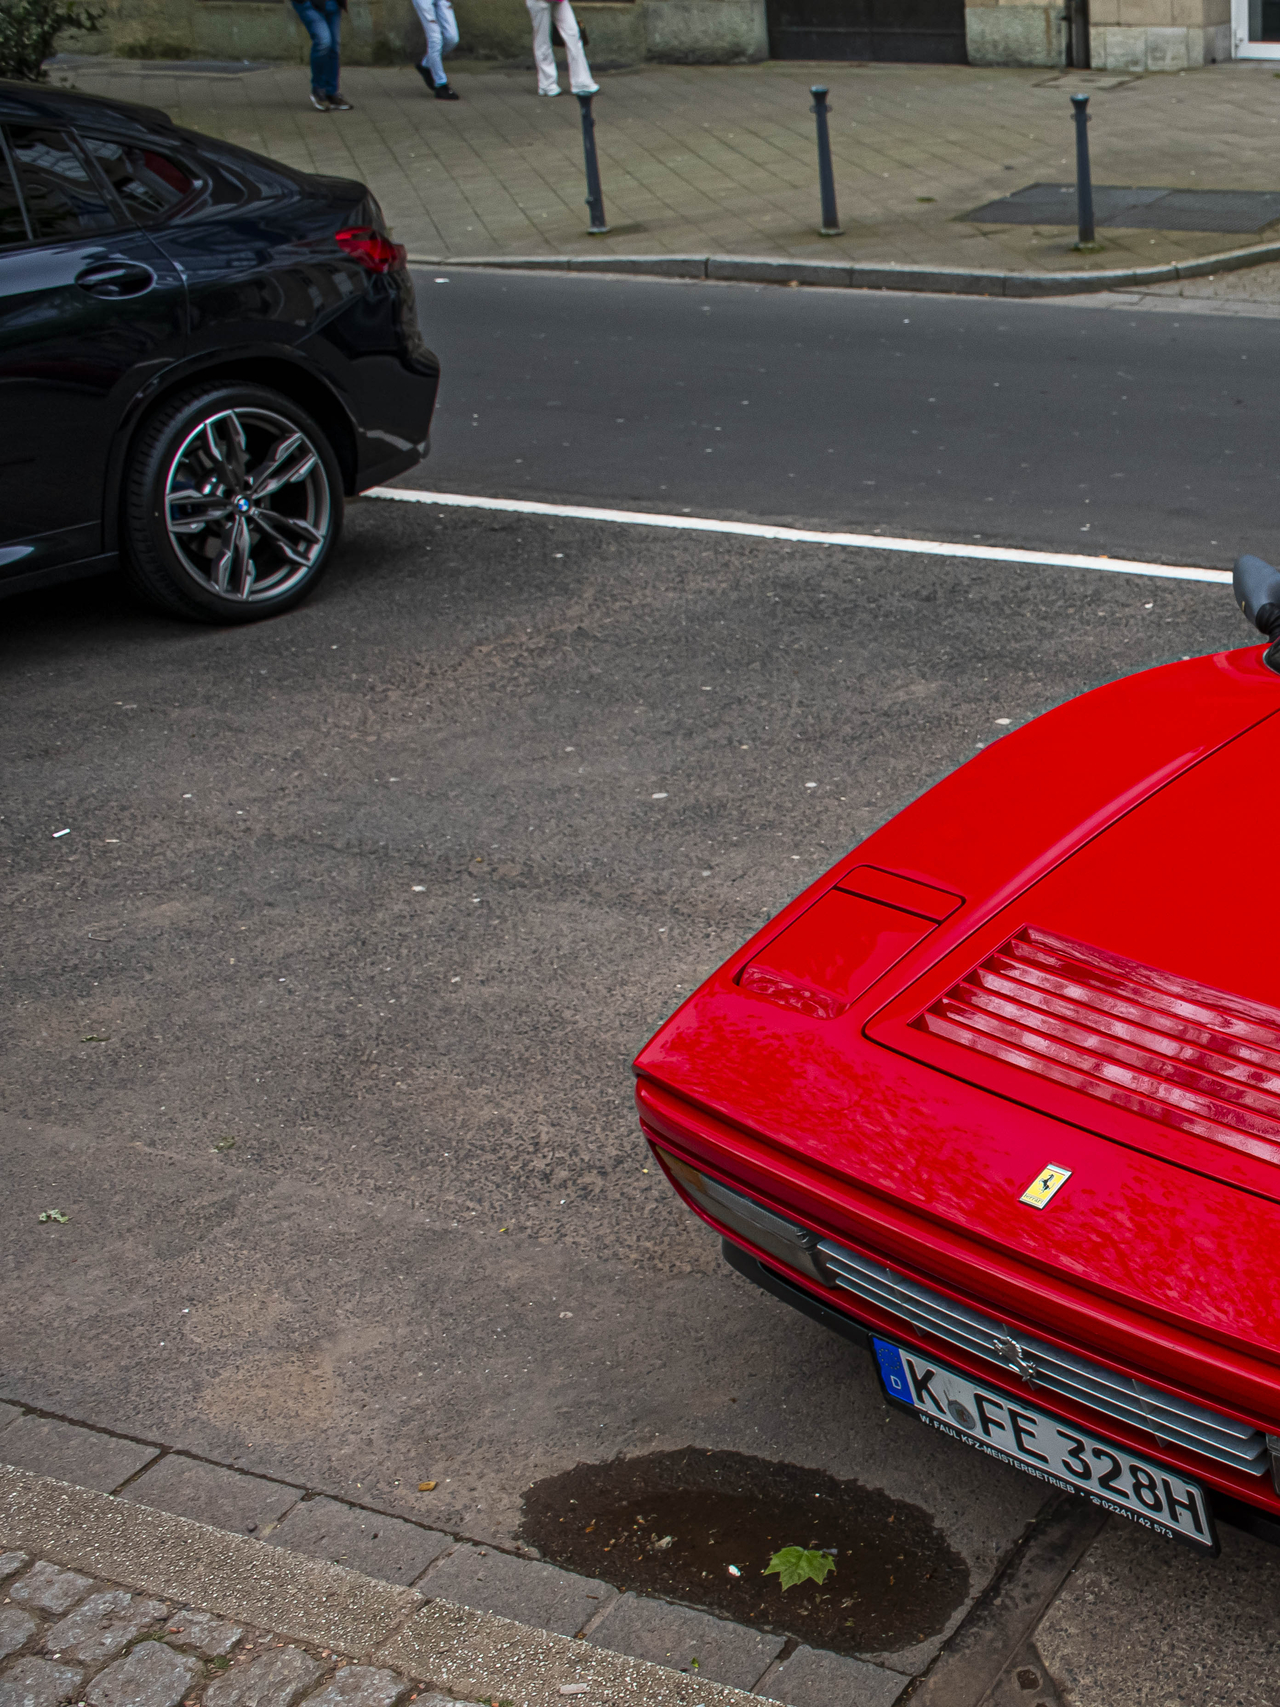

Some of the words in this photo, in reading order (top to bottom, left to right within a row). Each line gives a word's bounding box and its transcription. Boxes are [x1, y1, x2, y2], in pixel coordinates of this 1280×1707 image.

[890, 1375, 902, 1390] D
[906, 1358, 947, 1415] K
[973, 1391, 1050, 1464] FE
[1056, 1428, 1205, 1536] 328H
[919, 1413, 933, 1426] W.
[933, 1421, 960, 1440] FAUL
[960, 1434, 1075, 1494] KFZ-MEISTERBETRIEB
[1153, 1523, 1173, 1539] 573
